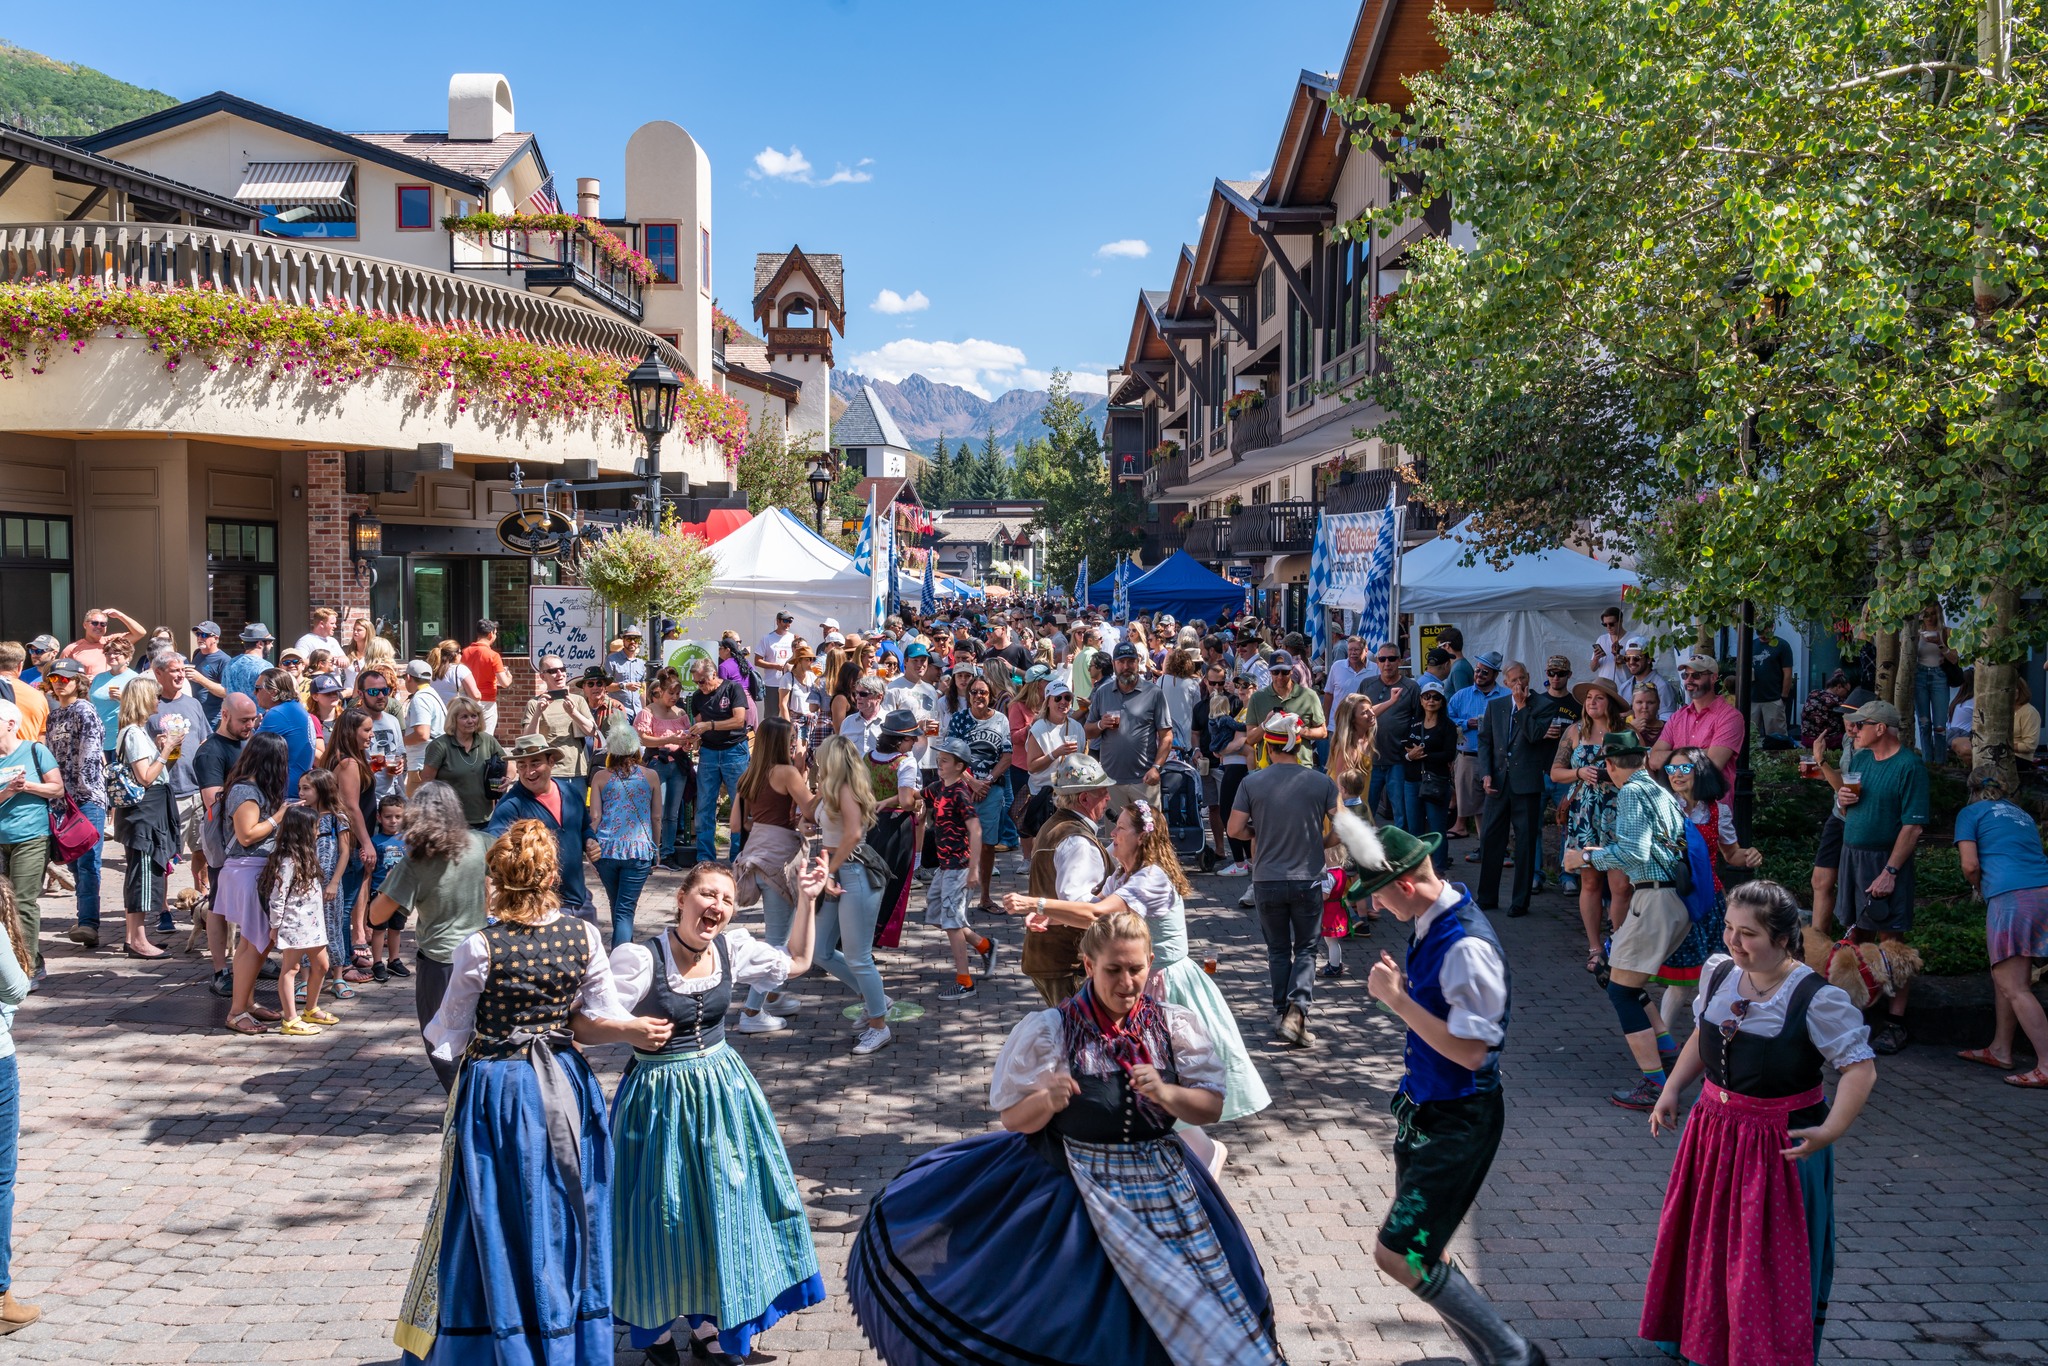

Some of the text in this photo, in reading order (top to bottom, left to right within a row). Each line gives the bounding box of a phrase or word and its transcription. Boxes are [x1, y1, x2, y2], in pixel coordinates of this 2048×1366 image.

[508, 536, 521, 544] THE
[567, 626, 587, 642] The
[567, 645, 595, 659] Bank
[672, 647, 698, 660] DISMOUNT
